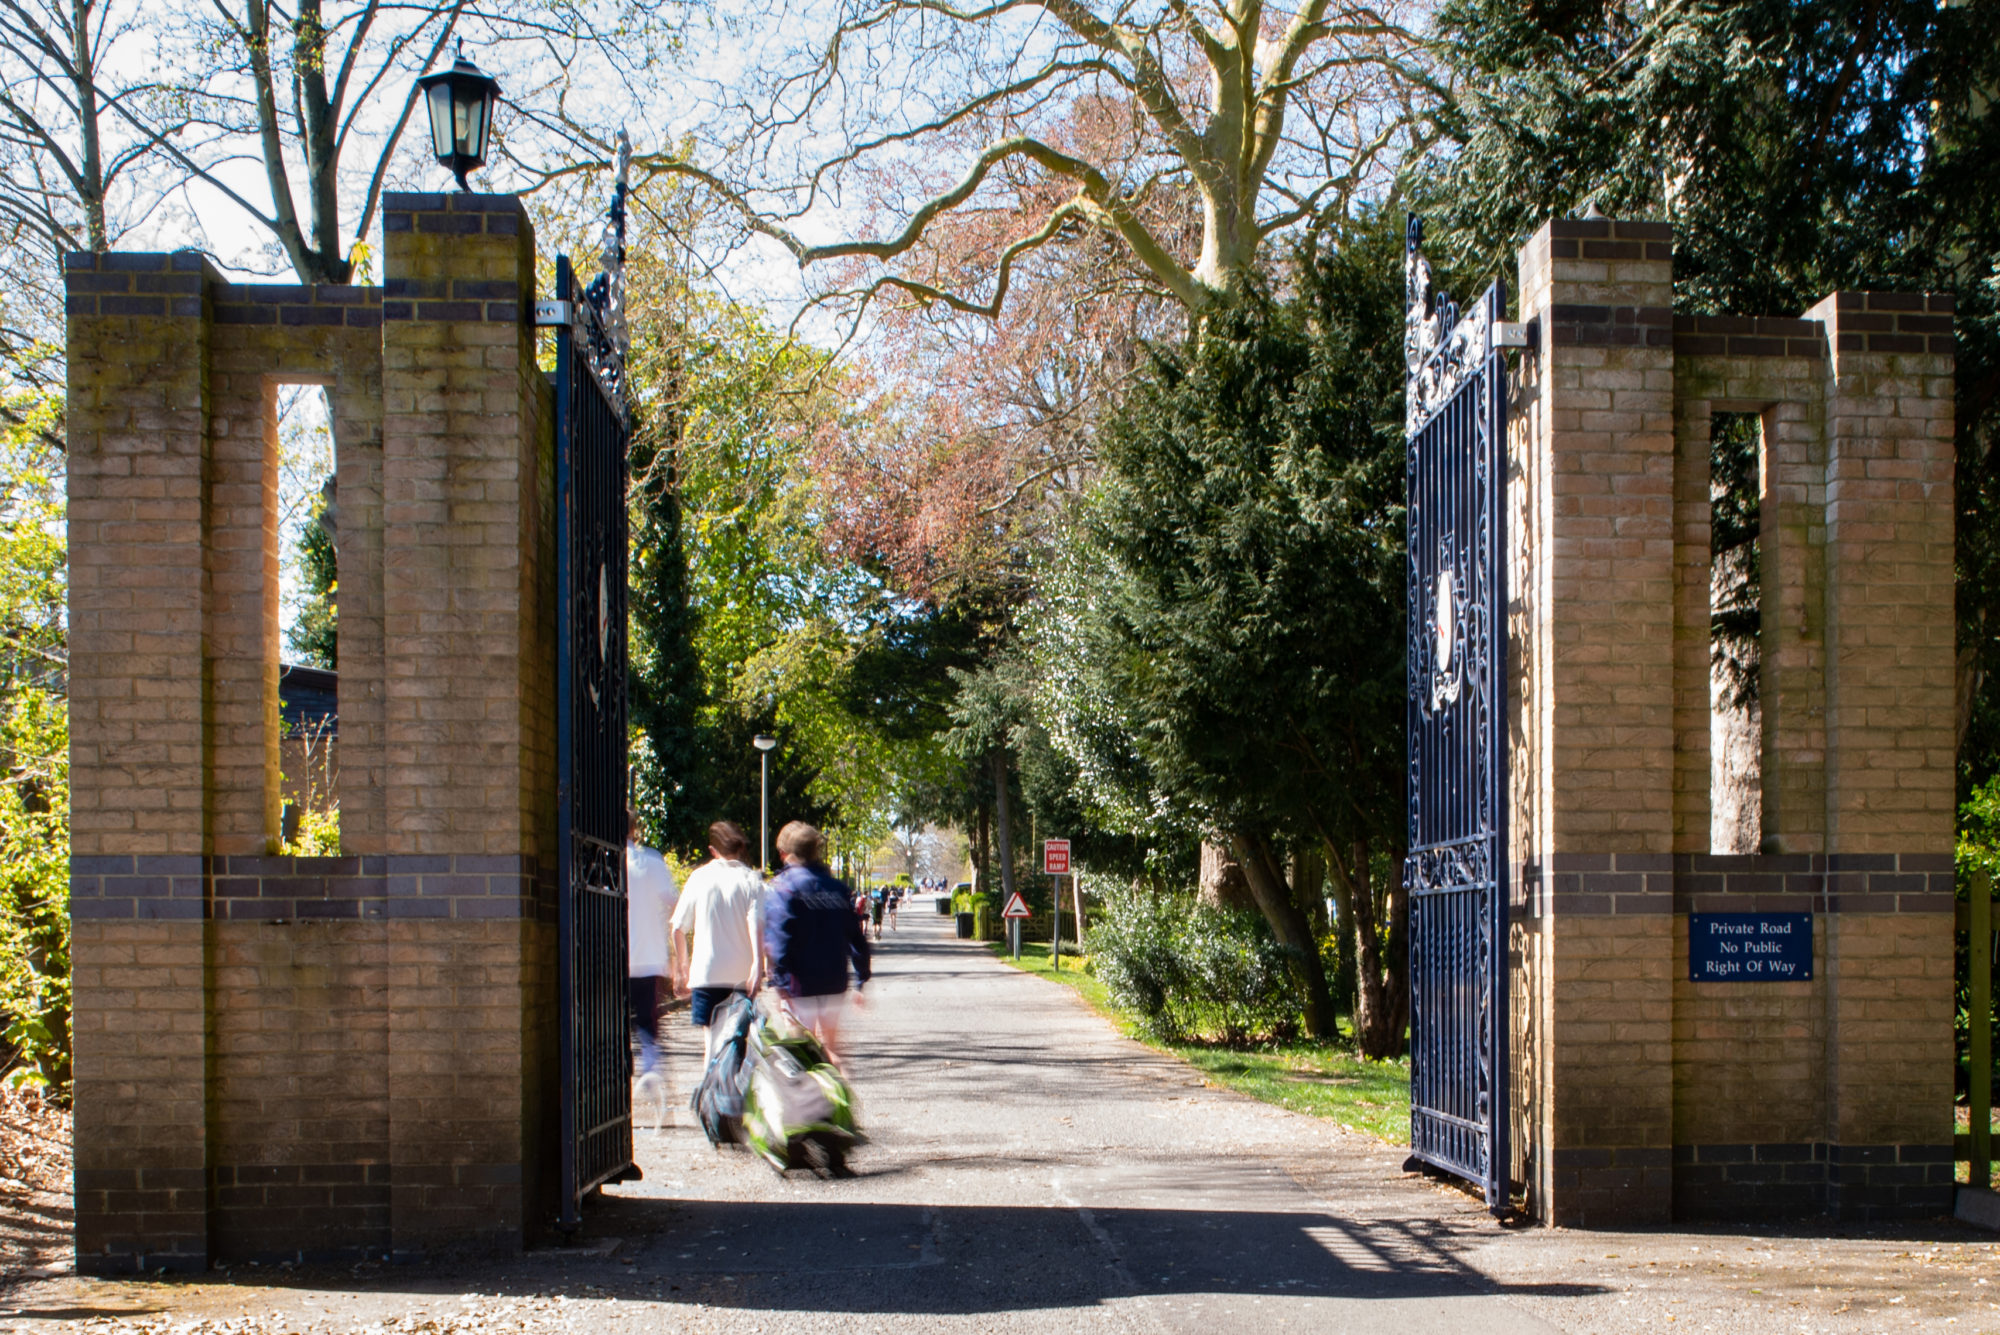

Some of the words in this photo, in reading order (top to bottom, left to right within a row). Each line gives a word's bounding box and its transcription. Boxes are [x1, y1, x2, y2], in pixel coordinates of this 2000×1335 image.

[1047, 843, 1068, 851] CAUTION
[1049, 853, 1066, 861] SPEED
[1710, 922, 1754, 934] Private
[1760, 922, 1792, 934] Road
[1720, 941, 1738, 953] No
[1744, 941, 1782, 953] Public
[1706, 960, 1741, 976] Right
[1746, 960, 1763, 972] Of
[1769, 960, 1796, 975] Way
